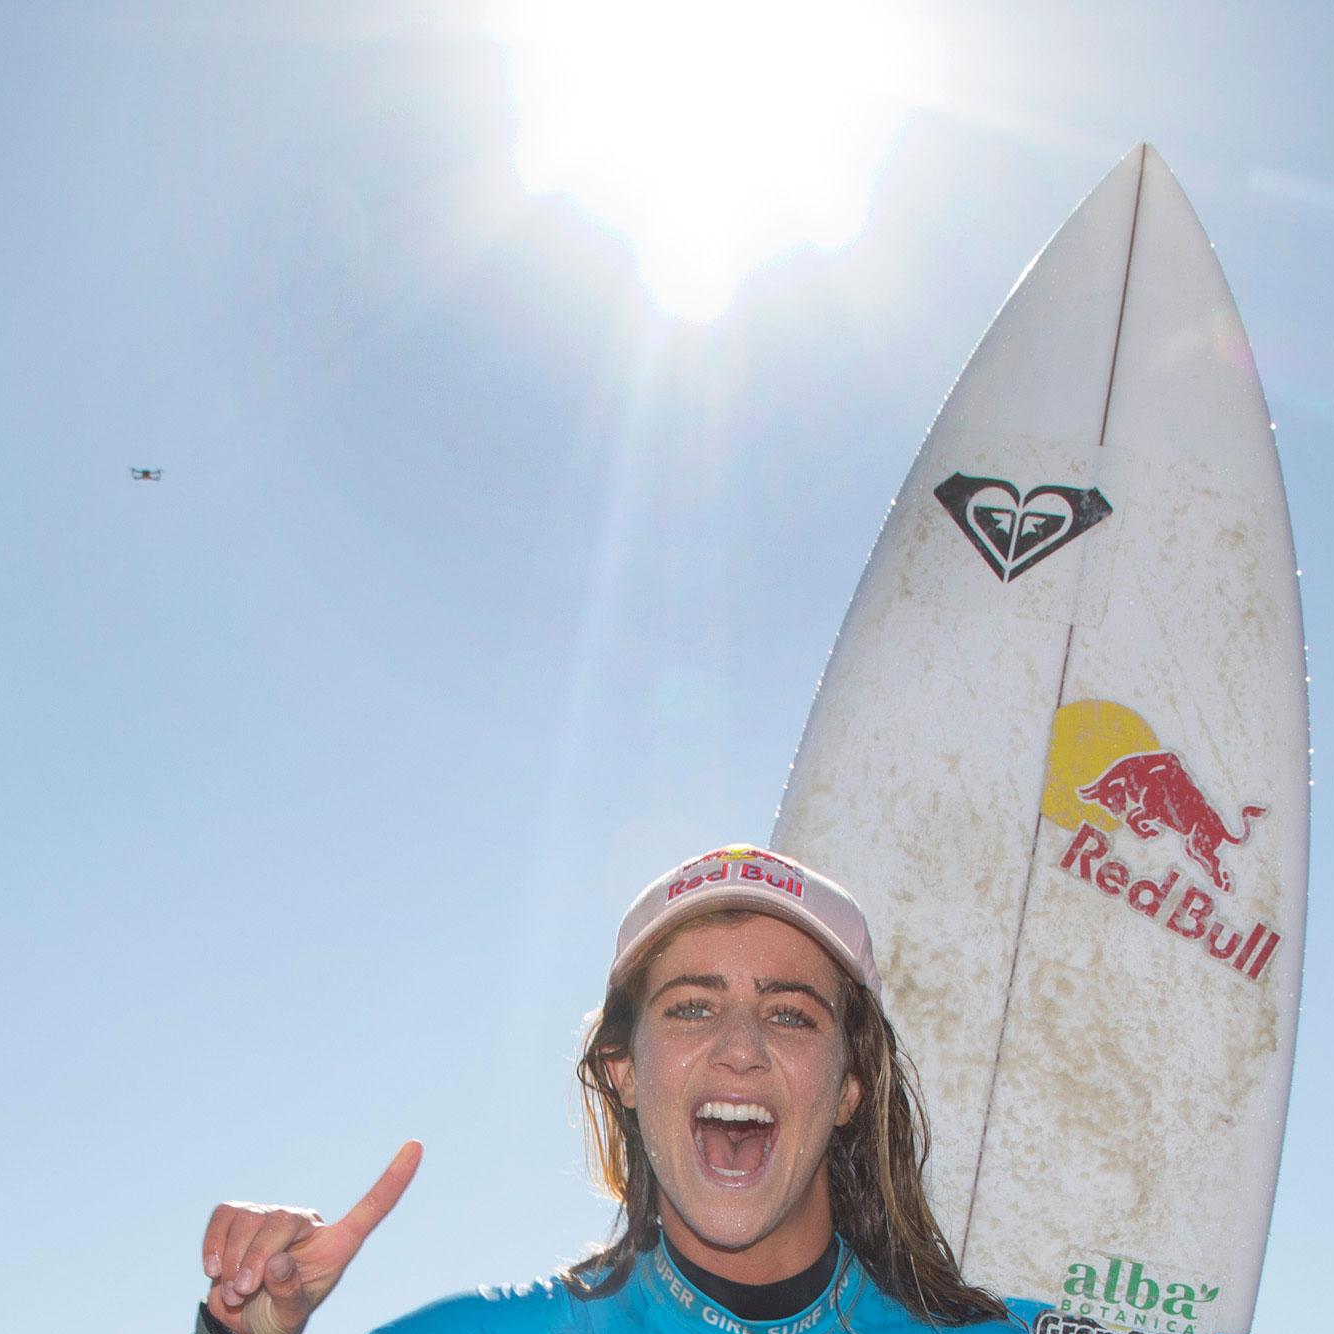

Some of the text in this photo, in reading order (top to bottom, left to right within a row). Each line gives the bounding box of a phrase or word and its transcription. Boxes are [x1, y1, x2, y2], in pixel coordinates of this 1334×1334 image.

[666, 862, 804, 903] Red Bull
[1060, 823, 1281, 980] Red Bull
[653, 1249, 694, 1309] SUPER
[1063, 1257, 1214, 1320] alba
